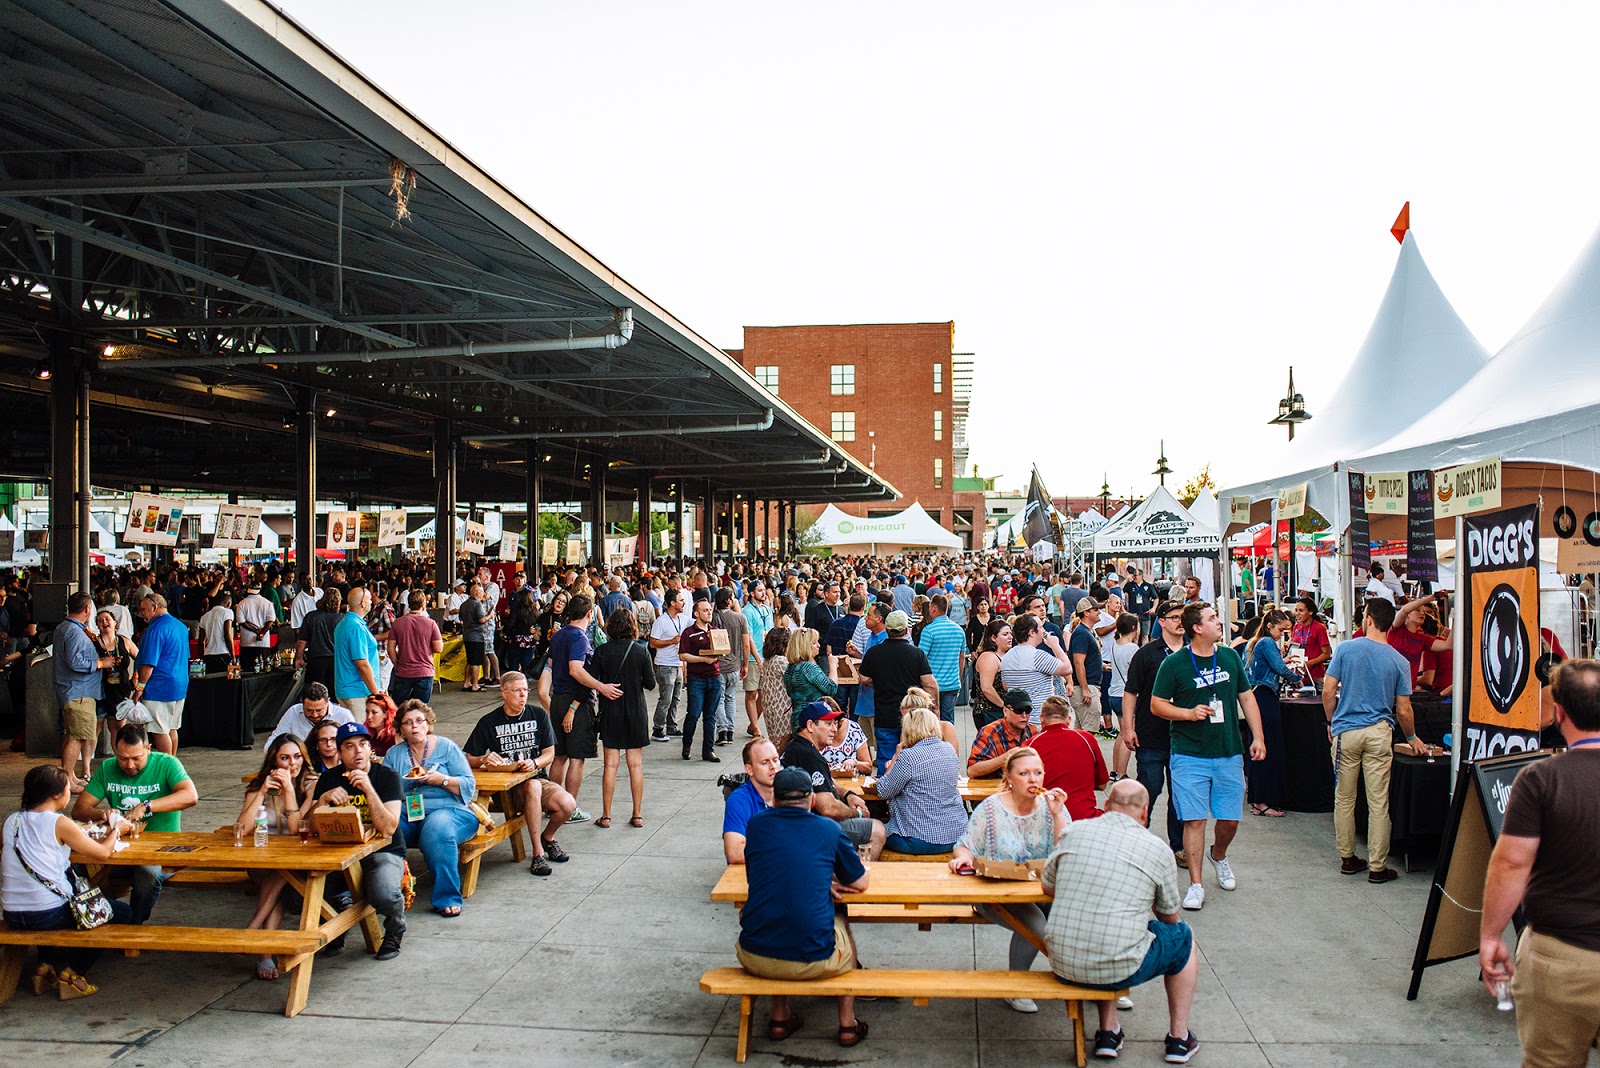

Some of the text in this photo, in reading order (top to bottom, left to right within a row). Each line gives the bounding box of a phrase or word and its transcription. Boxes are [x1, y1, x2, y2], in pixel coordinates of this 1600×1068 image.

[1456, 469, 1476, 498] DIGG'S
[1477, 463, 1497, 494] TACOS
[855, 523, 906, 531] HANGOUT
[1110, 535, 1238, 548] UNTAPPED FESTIVL
[1468, 519, 1534, 567] DIGG'S
[496, 568, 506, 598] ATM
[495, 720, 537, 736] WANTED
[500, 732, 536, 745] BELLATRIX
[501, 740, 536, 751] LESTRANGE
[107, 782, 160, 794] NEWPORT BEACH
